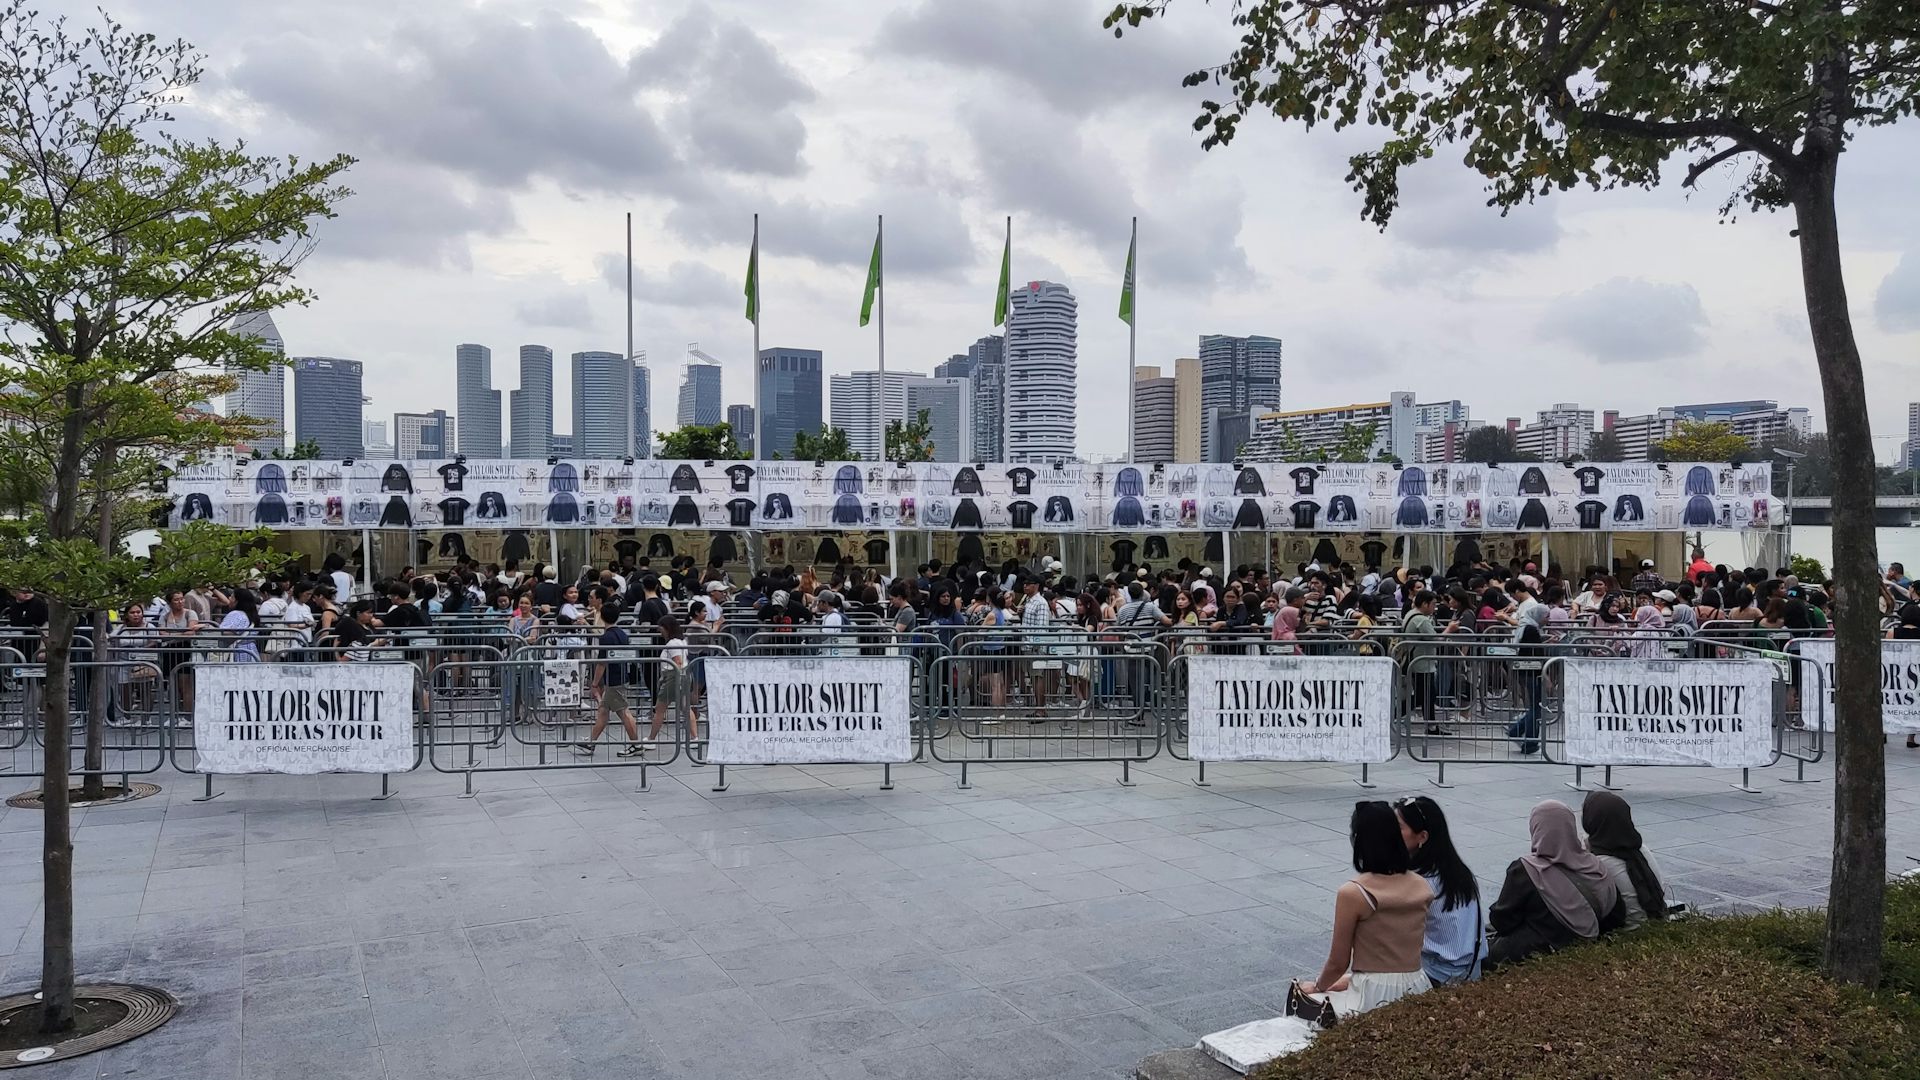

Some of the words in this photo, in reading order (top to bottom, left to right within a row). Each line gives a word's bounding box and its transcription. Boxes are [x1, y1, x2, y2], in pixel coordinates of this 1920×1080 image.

[470, 465, 494, 474] TAYLOR
[496, 465, 515, 474] SWIFT
[756, 467, 780, 476] TAYLOR
[782, 467, 800, 476] SWIFT
[1038, 470, 1062, 479] TAYLOR
[1064, 470, 1082, 479] SWIFT
[1347, 469, 1365, 478] SWIFT
[1606, 469, 1630, 478] TAYLOR
[1632, 469, 1651, 478] SWIFT
[732, 683, 814, 714] TAYLOR
[820, 683, 882, 713] SWIFT
[1215, 680, 1294, 710] TAYLOR
[1301, 679, 1364, 710] SWIFT
[1593, 684, 1673, 716] TAYLOR
[1679, 685, 1744, 716] SWIFT
[224, 689, 311, 722] TAYLOR
[317, 689, 383, 722] SWIFT
[734, 717, 773, 732] THE
[779, 716, 827, 731] ERAS
[832, 716, 882, 730] TOUR
[1216, 713, 1253, 728] THE
[1260, 713, 1307, 728] ERAS
[1312, 713, 1362, 727] TOUR
[1594, 716, 1633, 731] THE
[1638, 718, 1686, 733] ERAS
[1691, 718, 1742, 733] TOUR
[225, 725, 265, 740] THE
[272, 724, 324, 740] ERAS
[328, 724, 383, 740] TOUR
[1624, 737, 1658, 745] OFFICIAL
